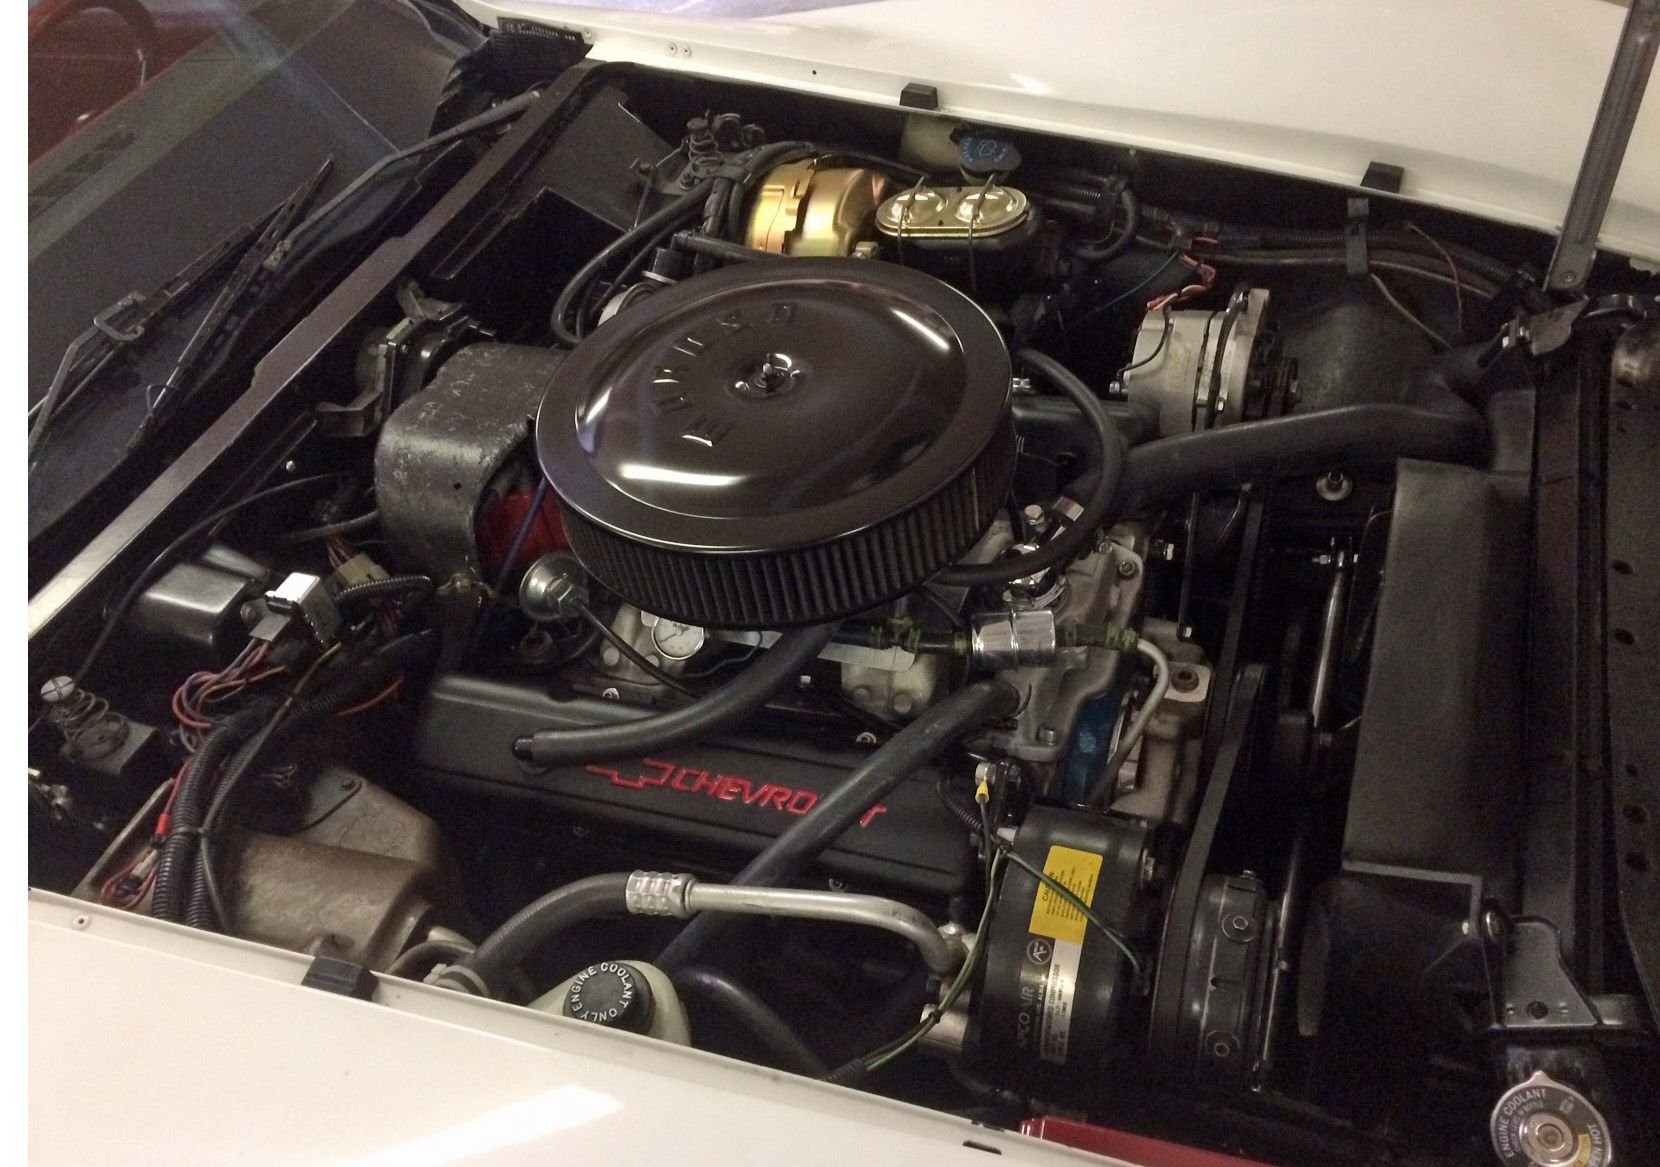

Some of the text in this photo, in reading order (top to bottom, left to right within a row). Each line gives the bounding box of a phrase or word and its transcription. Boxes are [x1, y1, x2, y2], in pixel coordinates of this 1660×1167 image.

[671, 768, 887, 828] CHEVROT
[1042, 872, 1057, 902] CAUN
[570, 961, 633, 1022] ENGINE COOLANT ONLY
[1498, 1087, 1547, 1159] ENGINE COOLANT
[1587, 1122, 1602, 1145] HOT
